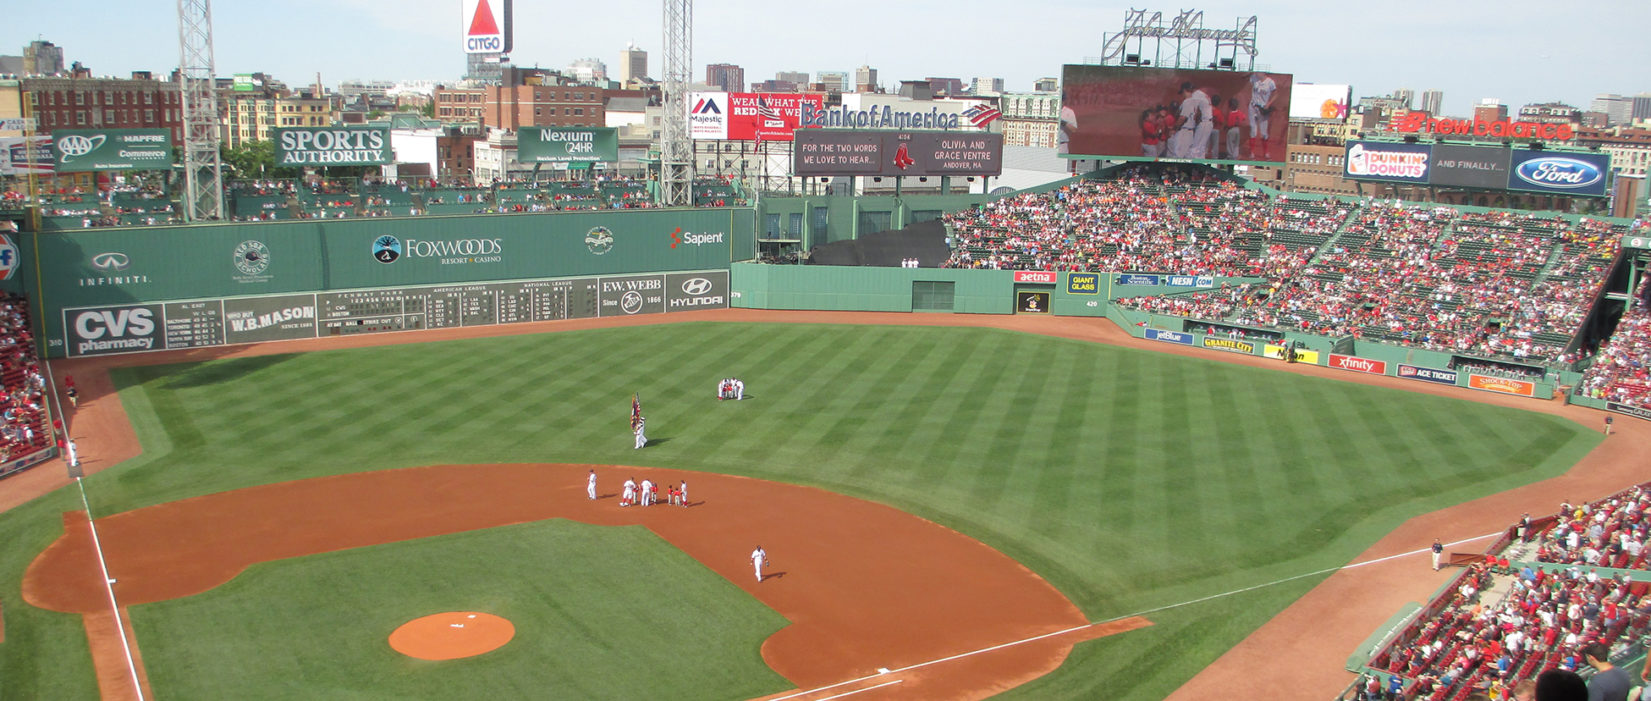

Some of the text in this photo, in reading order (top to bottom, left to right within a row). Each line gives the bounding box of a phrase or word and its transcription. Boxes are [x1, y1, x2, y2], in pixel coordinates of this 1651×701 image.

[467, 36, 500, 50] CITGO
[732, 97, 760, 107] WEA
[764, 98, 795, 107] WHAT
[734, 107, 757, 116] RED
[800, 103, 852, 127] Bank
[852, 104, 878, 128] of
[880, 105, 960, 129] America
[691, 115, 722, 124] Majestic
[1426, 117, 1472, 136] new
[1473, 114, 1574, 140] balance
[123, 135, 165, 143] MAPFRE
[281, 130, 384, 151] SPORTS
[540, 128, 593, 142] Nexium
[62, 136, 90, 154] AAA
[802, 143, 878, 154] FOR THE TWO WORDS
[941, 140, 986, 150] OLIVIA AND
[119, 150, 166, 158] Commerce
[934, 151, 992, 160] GRACE VENTRE
[803, 155, 815, 164] WE
[816, 155, 837, 165] LOVE
[838, 156, 848, 165] TO
[1436, 160, 1455, 169] AND
[942, 162, 971, 170] ANDOVER,
[1369, 164, 1422, 176] DONUTS
[1532, 161, 1586, 183] Ford
[683, 231, 723, 247] Sapient
[405, 238, 503, 258] FOXWOODS
[474, 255, 502, 263] CASINO
[1020, 272, 1051, 281] aetna
[626, 279, 662, 291] WEBB
[1072, 283, 1095, 291] GLASS
[338, 291, 374, 299] FENWAY
[670, 296, 723, 307] HYUNDAI
[75, 307, 155, 340] CVS
[1158, 331, 1182, 341] jetBlue
[48, 339, 63, 347] 310
[79, 337, 154, 354] pharmacy
[1204, 338, 1235, 348] GRANITE
[1237, 341, 1253, 352] CITY
[1339, 357, 1375, 372] xfinity
[1416, 369, 1431, 378] ACE
[1432, 371, 1456, 381] TICKET
